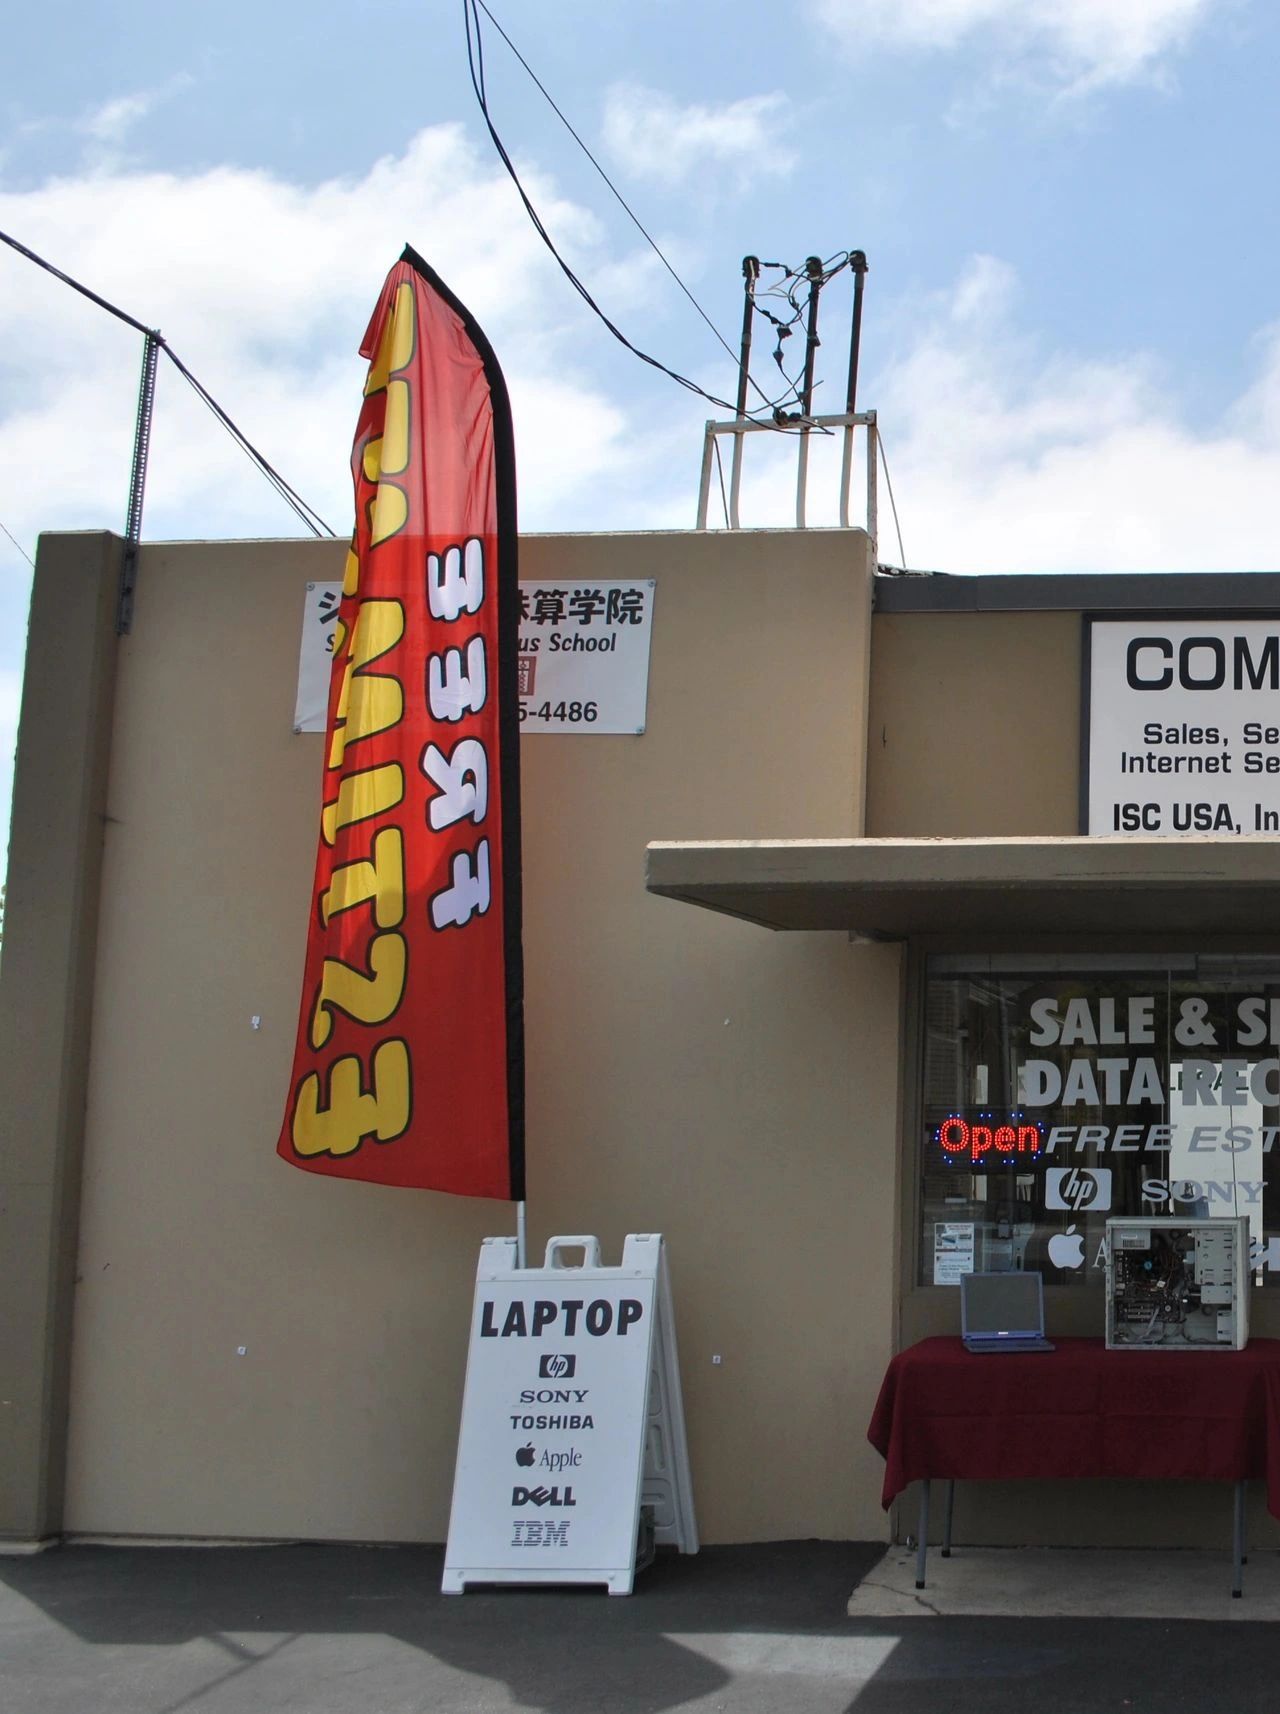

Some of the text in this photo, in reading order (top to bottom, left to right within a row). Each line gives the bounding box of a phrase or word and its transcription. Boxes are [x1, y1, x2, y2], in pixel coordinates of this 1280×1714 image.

[549, 632, 617, 652] School
[1143, 722, 1229, 747] Sales,
[1121, 751, 1232, 774] Internet
[1113, 802, 1161, 832] ISC
[1172, 802, 1242, 834] USA,
[1029, 997, 1155, 1046] SALE
[1174, 997, 1219, 1046] &
[1022, 1057, 1166, 1107] DATA
[939, 1118, 1039, 1159] Open
[1045, 1124, 1178, 1154] FREE
[1141, 1179, 1268, 1203] SONY
[480, 1299, 643, 1338] LAPTOP
[519, 1389, 589, 1404] SONY
[509, 1415, 594, 1430] TOSHIBA
[539, 1448, 583, 1472] Apple
[511, 1486, 577, 1507] DELL
[511, 1520, 571, 1547] IBM
